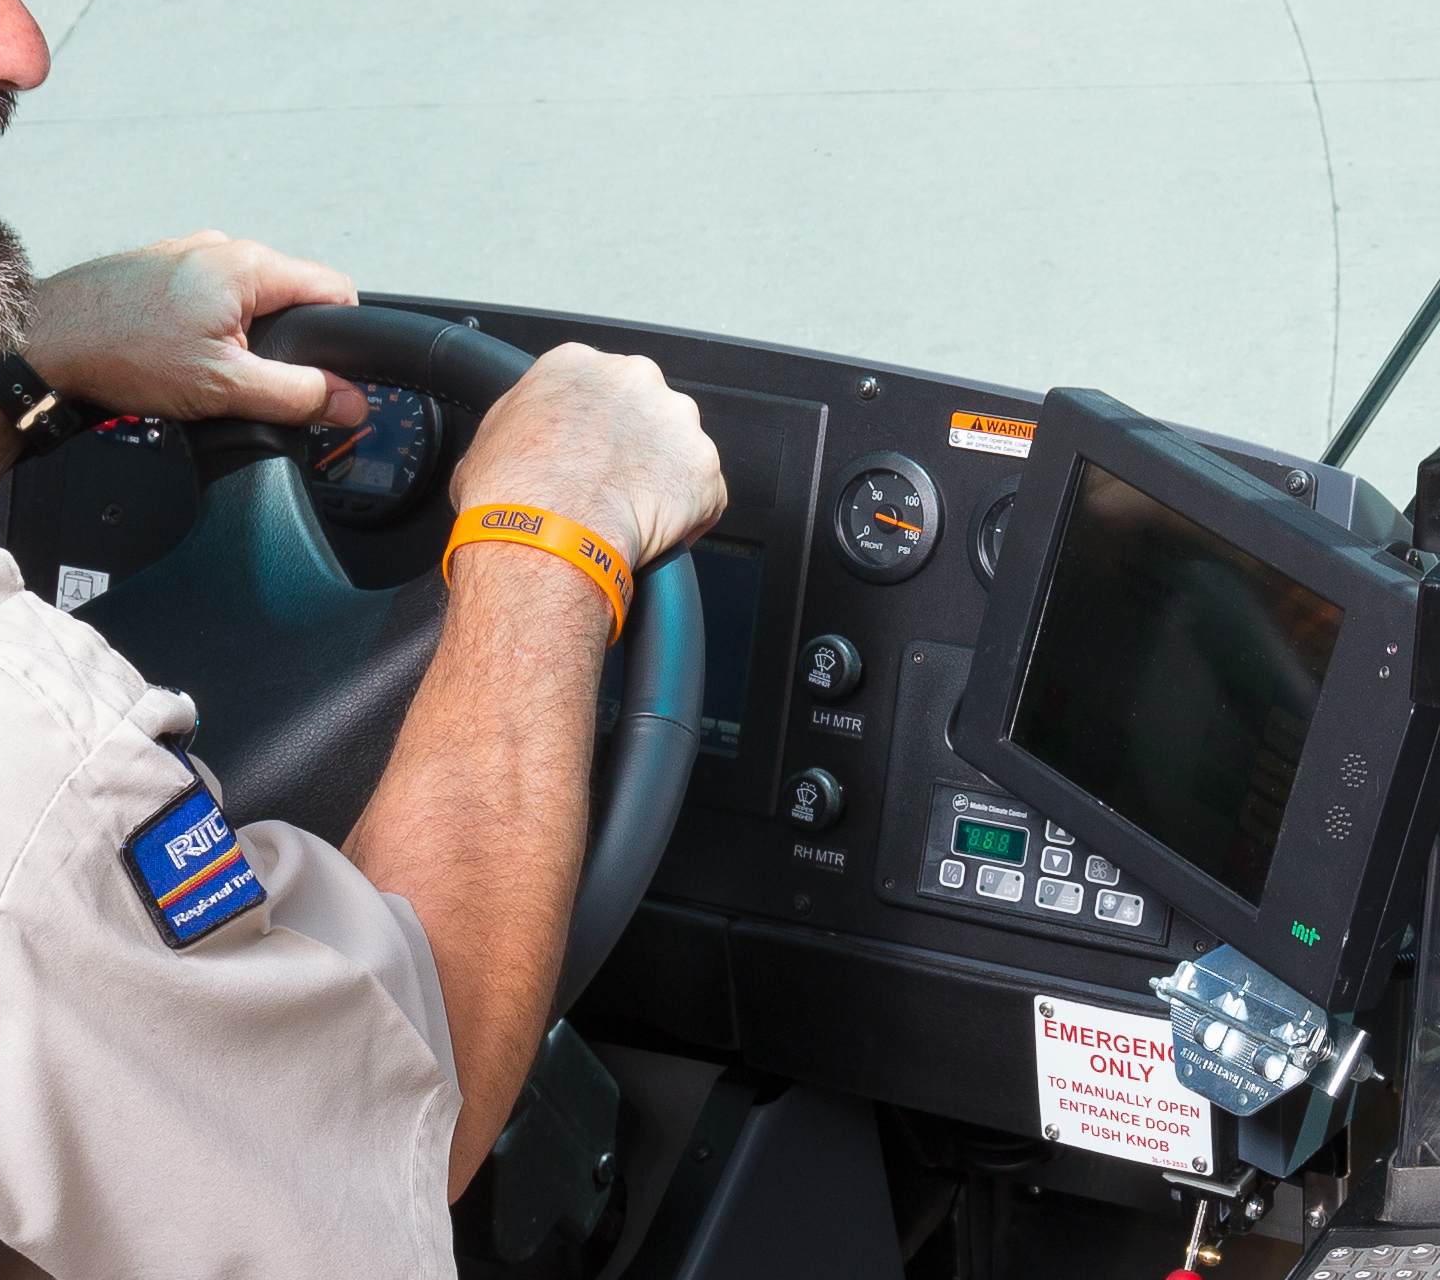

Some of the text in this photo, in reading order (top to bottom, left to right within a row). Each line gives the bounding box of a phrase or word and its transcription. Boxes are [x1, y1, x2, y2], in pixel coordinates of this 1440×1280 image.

[986, 419, 1034, 439] WARNI
[871, 490, 884, 502] 50
[904, 495, 920, 508] 100
[481, 509, 544, 535] RTD
[863, 525, 871, 535] 0
[860, 540, 883, 551] FRONT
[904, 530, 920, 541] 150
[578, 537, 613, 574] ME
[897, 546, 911, 555] PSI
[812, 710, 862, 733] LH MTR
[969, 801, 1028, 819] Mobile Climate Control
[793, 844, 845, 866] RH MTR
[171, 881, 234, 927] Regional
[1291, 920, 1321, 946] init
[1089, 1054, 1155, 1083] ONLY
[1047, 1075, 1200, 1119] TO MANUALLY OPEN
[1059, 1098, 1191, 1137] ENTRANCE DOOR
[1081, 1122, 1170, 1152] PUSH KNOB
[1372, 1247, 1389, 1256] 7
[1412, 1246, 1429, 1255] 4
